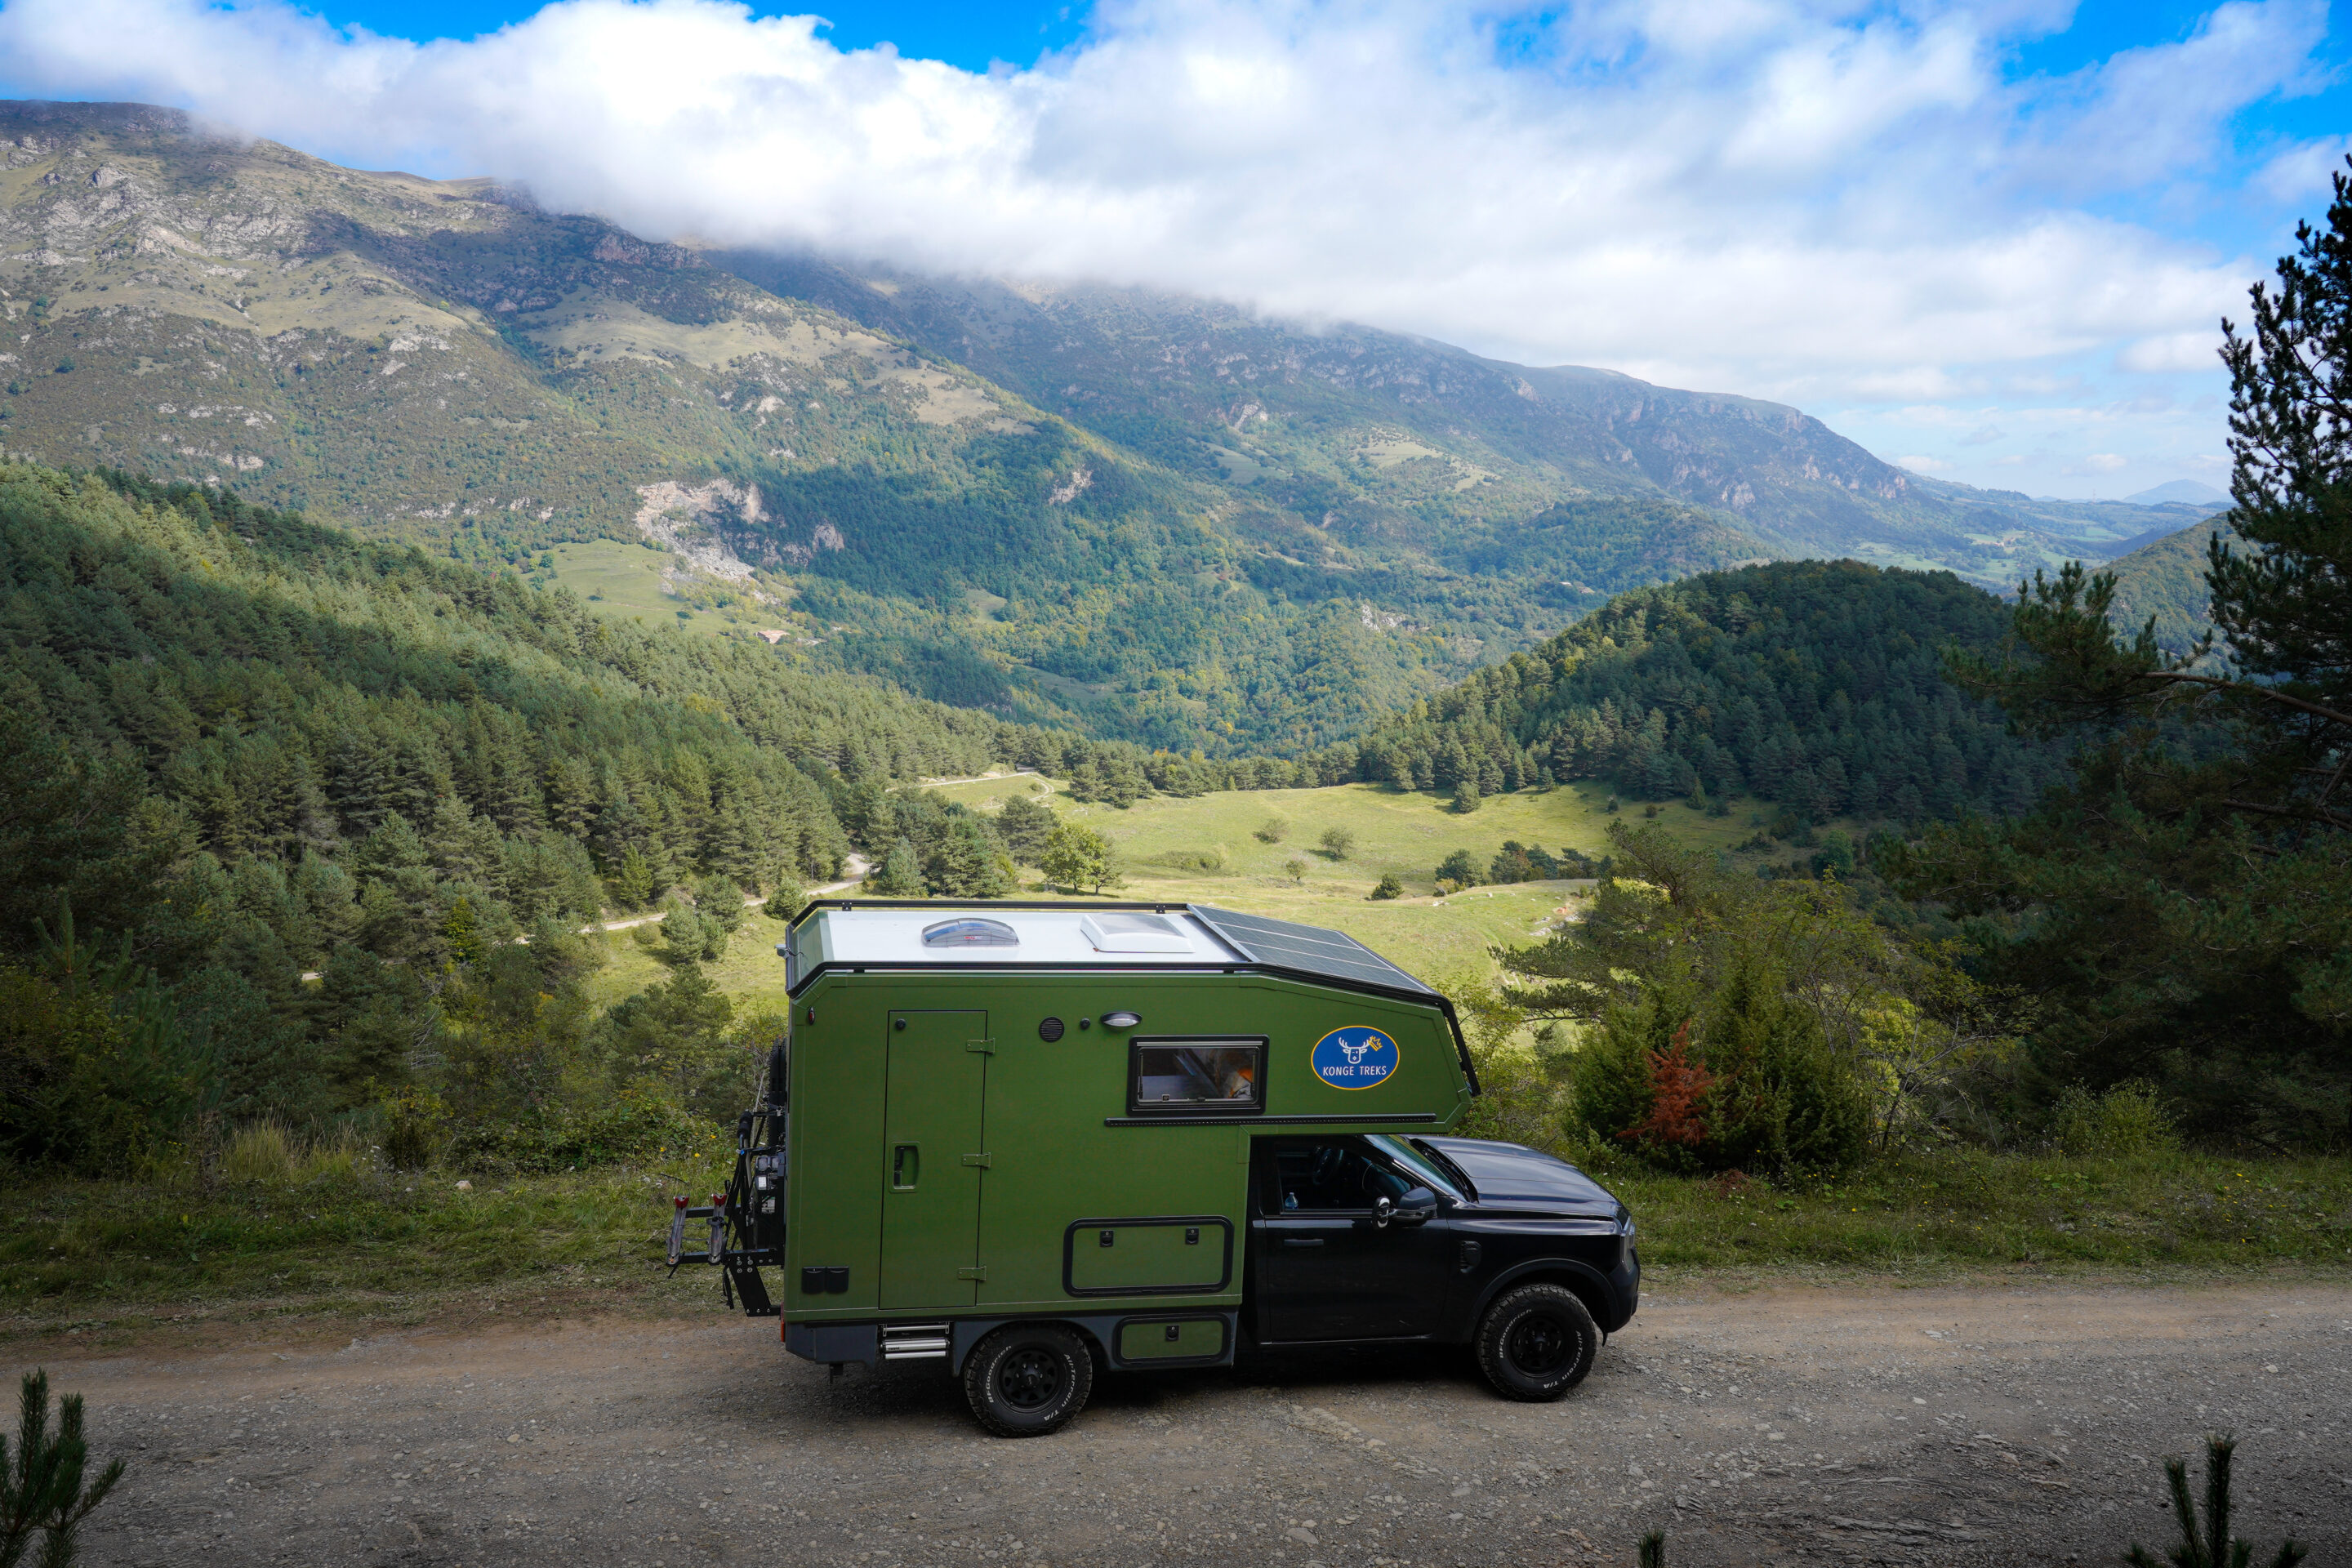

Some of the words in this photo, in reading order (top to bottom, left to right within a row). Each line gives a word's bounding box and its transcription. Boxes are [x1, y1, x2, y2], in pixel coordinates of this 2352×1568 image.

[1323, 1067, 1354, 1076] KONGE
[1360, 1066, 1387, 1076] TREKS
[1499, 1309, 1533, 1359] BFGoodrich
[986, 1345, 1012, 1403] BFGoodrich
[1062, 1353, 1076, 1407] All-Terrain
[1544, 1380, 1558, 1388] T/A
[1044, 1410, 1059, 1421] T/A
